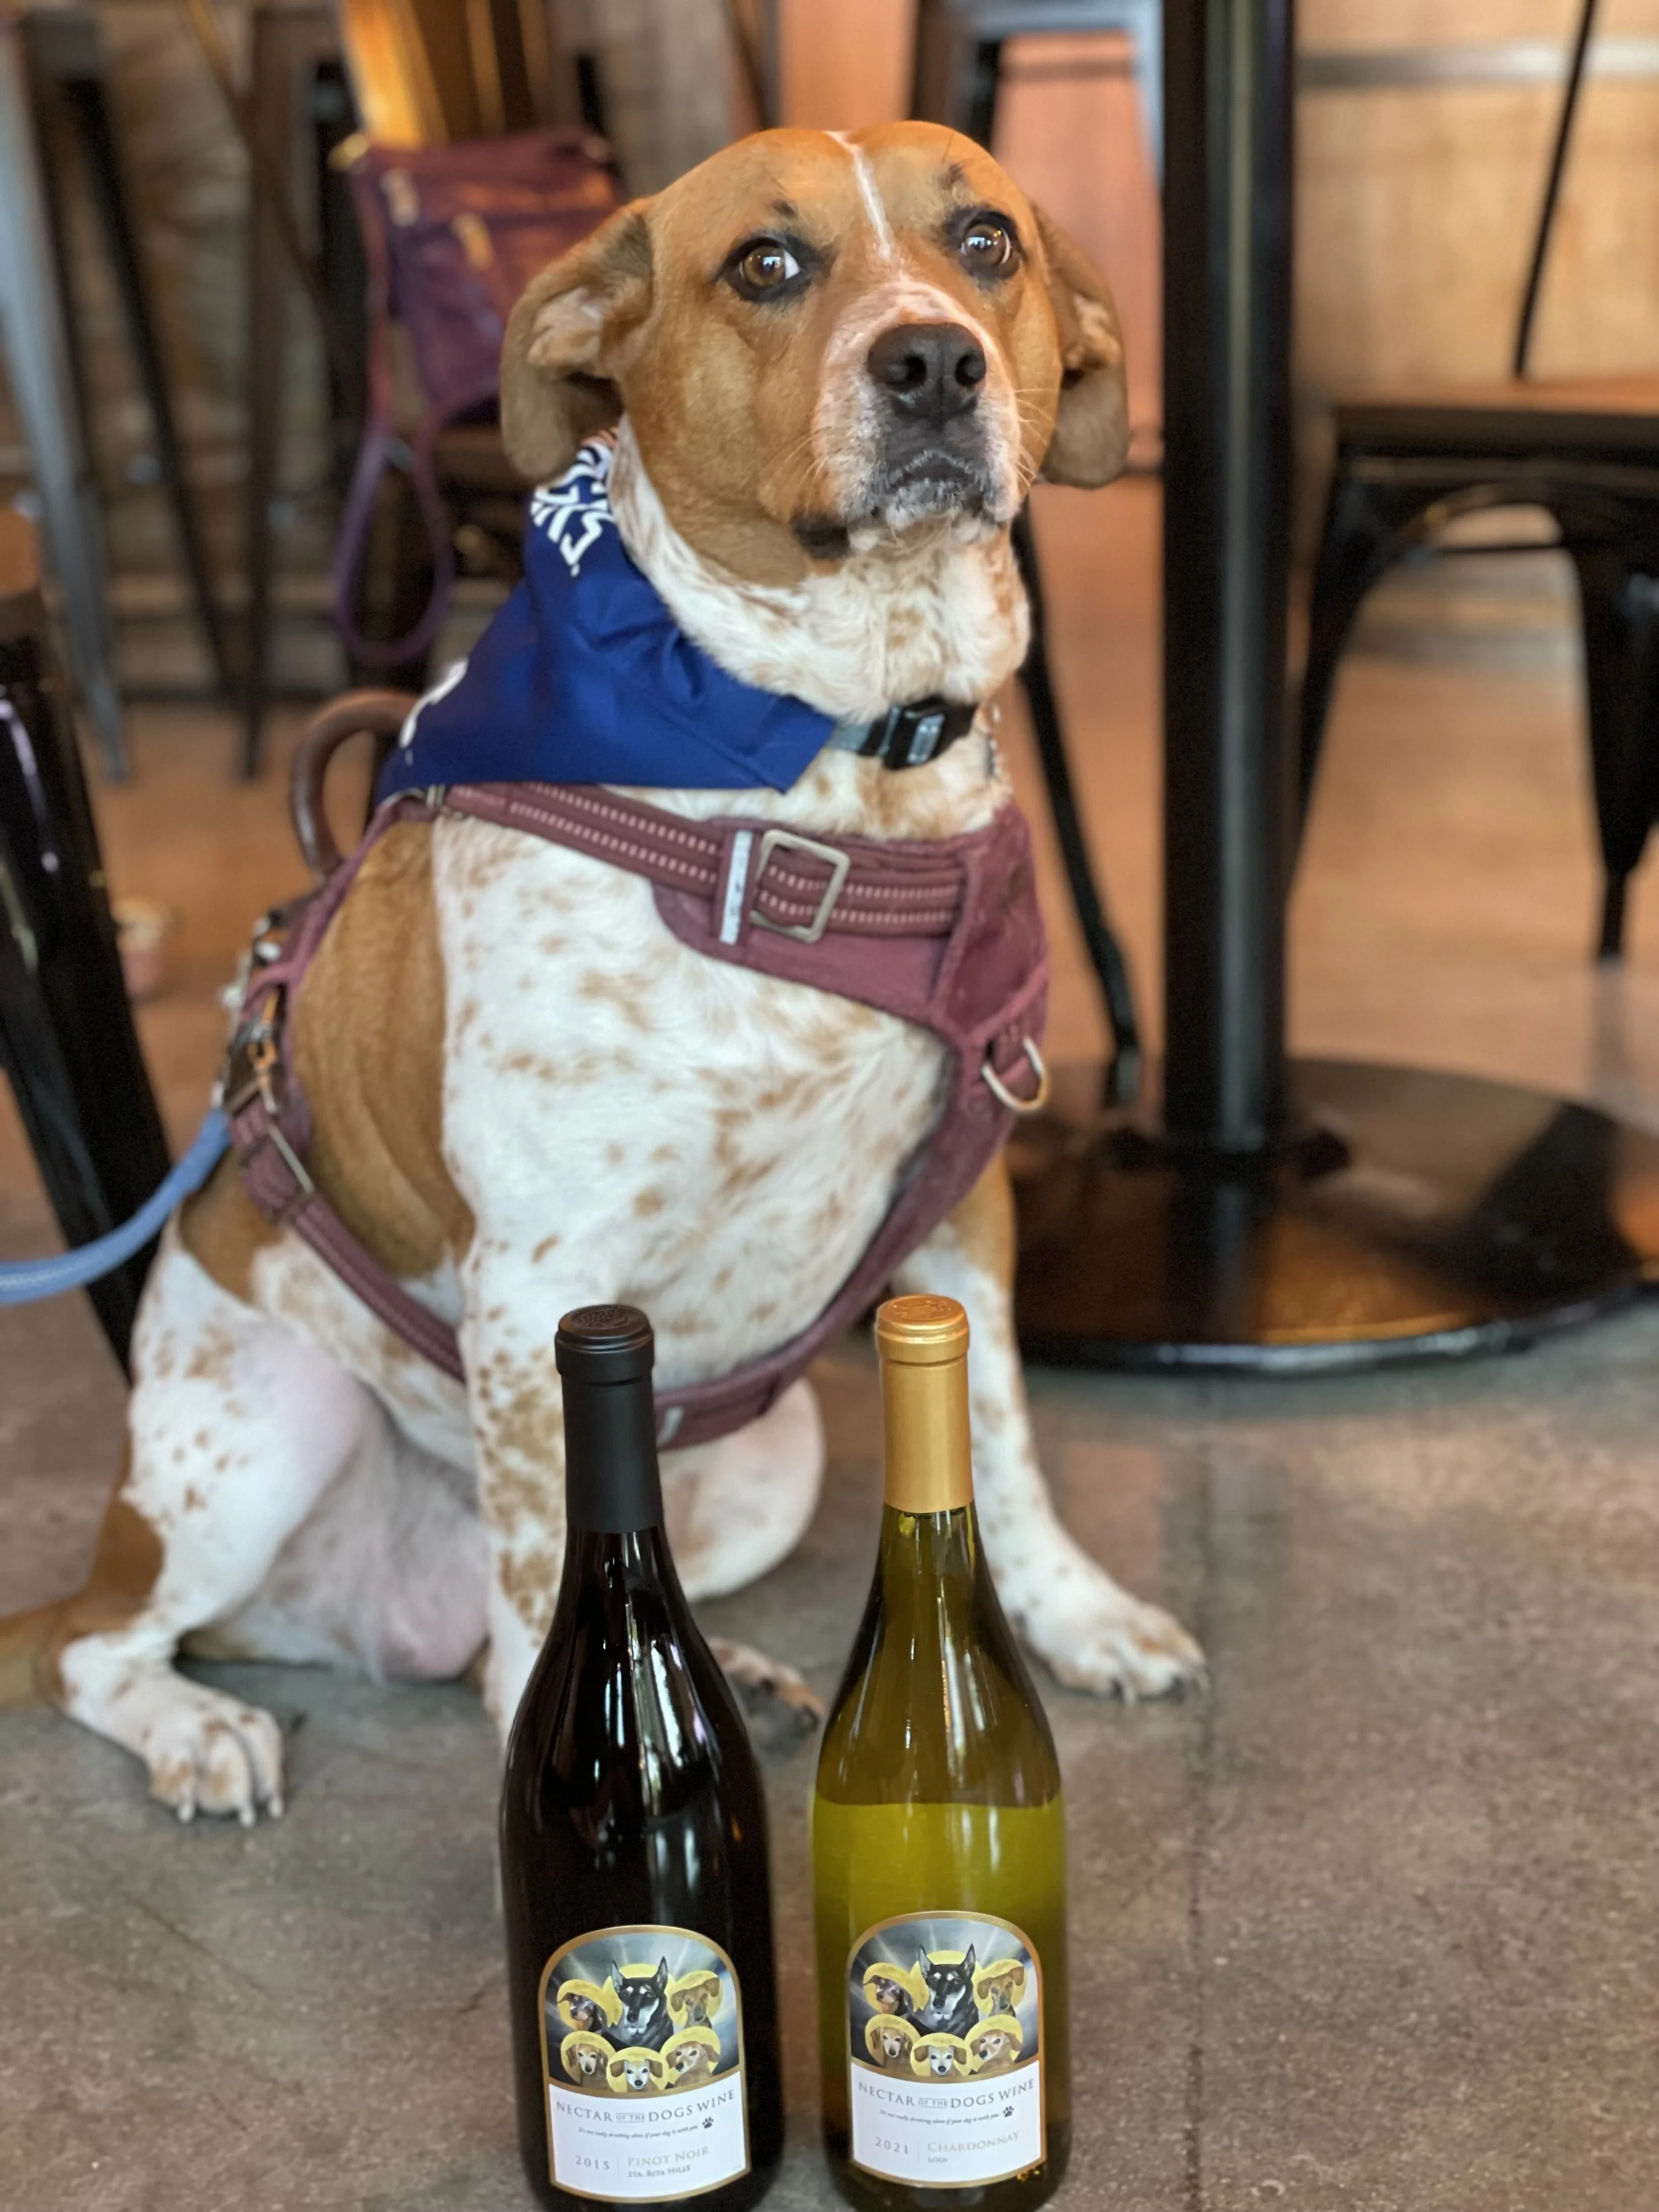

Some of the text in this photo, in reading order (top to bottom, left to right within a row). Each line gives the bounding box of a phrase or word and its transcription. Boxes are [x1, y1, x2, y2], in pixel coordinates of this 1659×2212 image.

[859, 2081, 915, 2106] NECTAR
[951, 2093, 994, 2108] DOGS
[999, 2079, 1033, 2101] WINE
[556, 2101, 613, 2122] NECTAR
[648, 2104, 693, 2122] DOGS
[697, 2089, 735, 2112] WINE
[875, 2137, 908, 2154] 2021
[928, 2130, 1020, 2152] CHARDONNAY
[575, 2155, 610, 2170] 2015
[628, 2146, 709, 2167] PINOT NOIR
